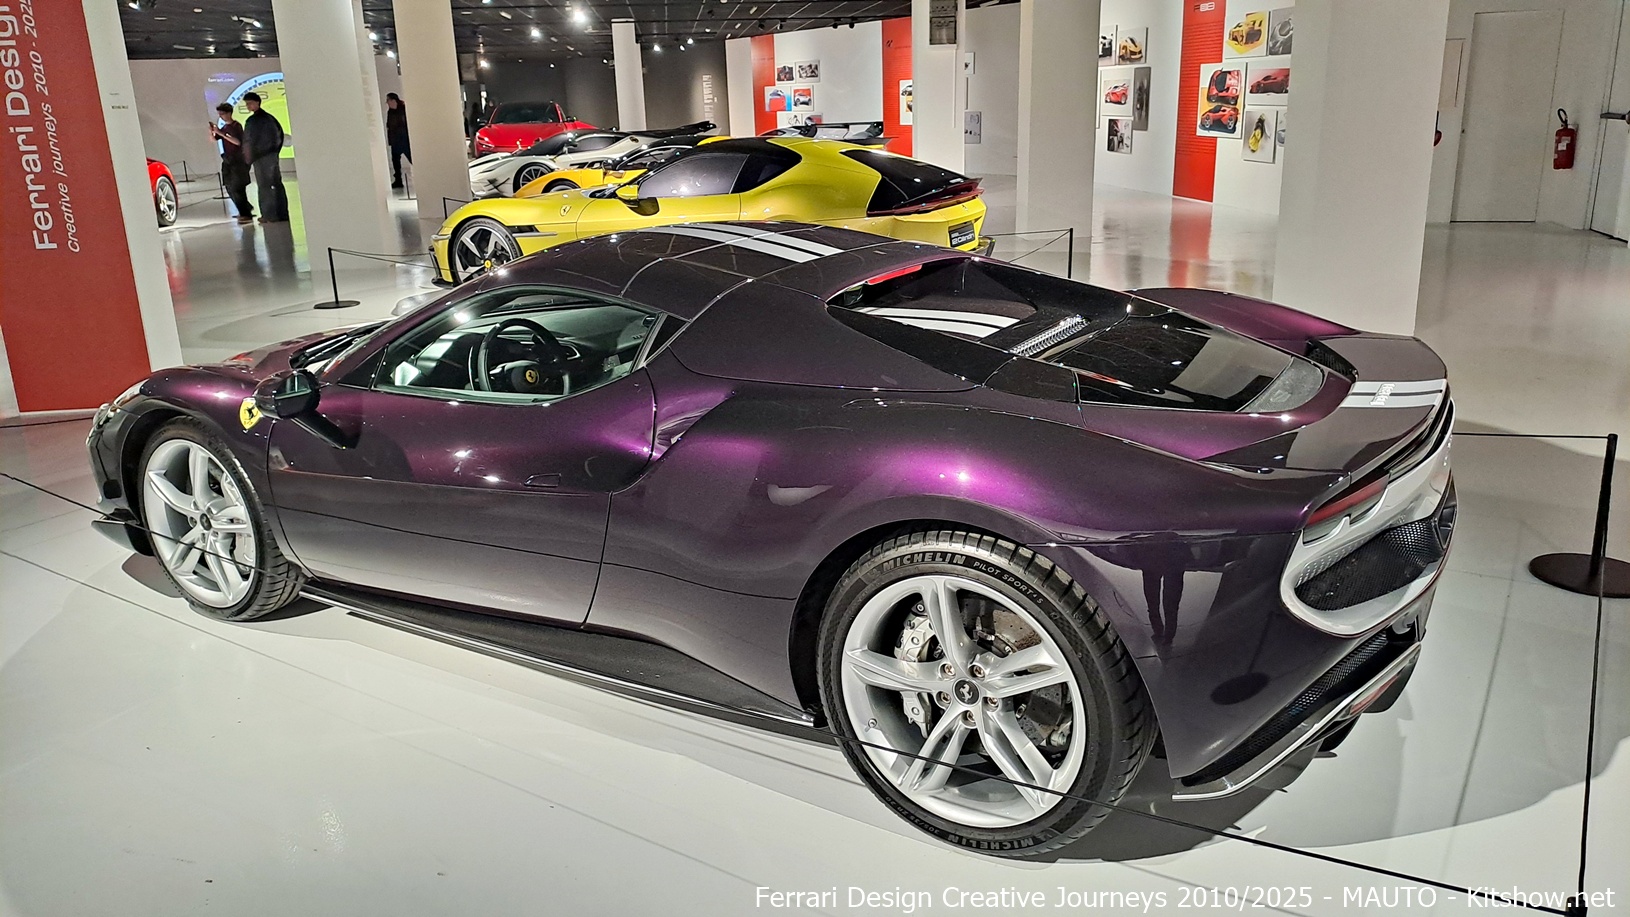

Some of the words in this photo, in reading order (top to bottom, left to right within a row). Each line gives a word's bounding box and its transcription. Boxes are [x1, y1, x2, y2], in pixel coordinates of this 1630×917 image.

[0, 5, 30, 116] Desig
[29, 51, 48, 96] 2010
[42, 103, 68, 177] journeys
[9, 126, 58, 250] Ferrari
[54, 184, 80, 253] Creative
[883, 552, 966, 572] MICHELIN
[973, 561, 1001, 576] PILOT
[1002, 573, 1034, 595] SPORT
[947, 834, 1034, 850] MICHELIN
